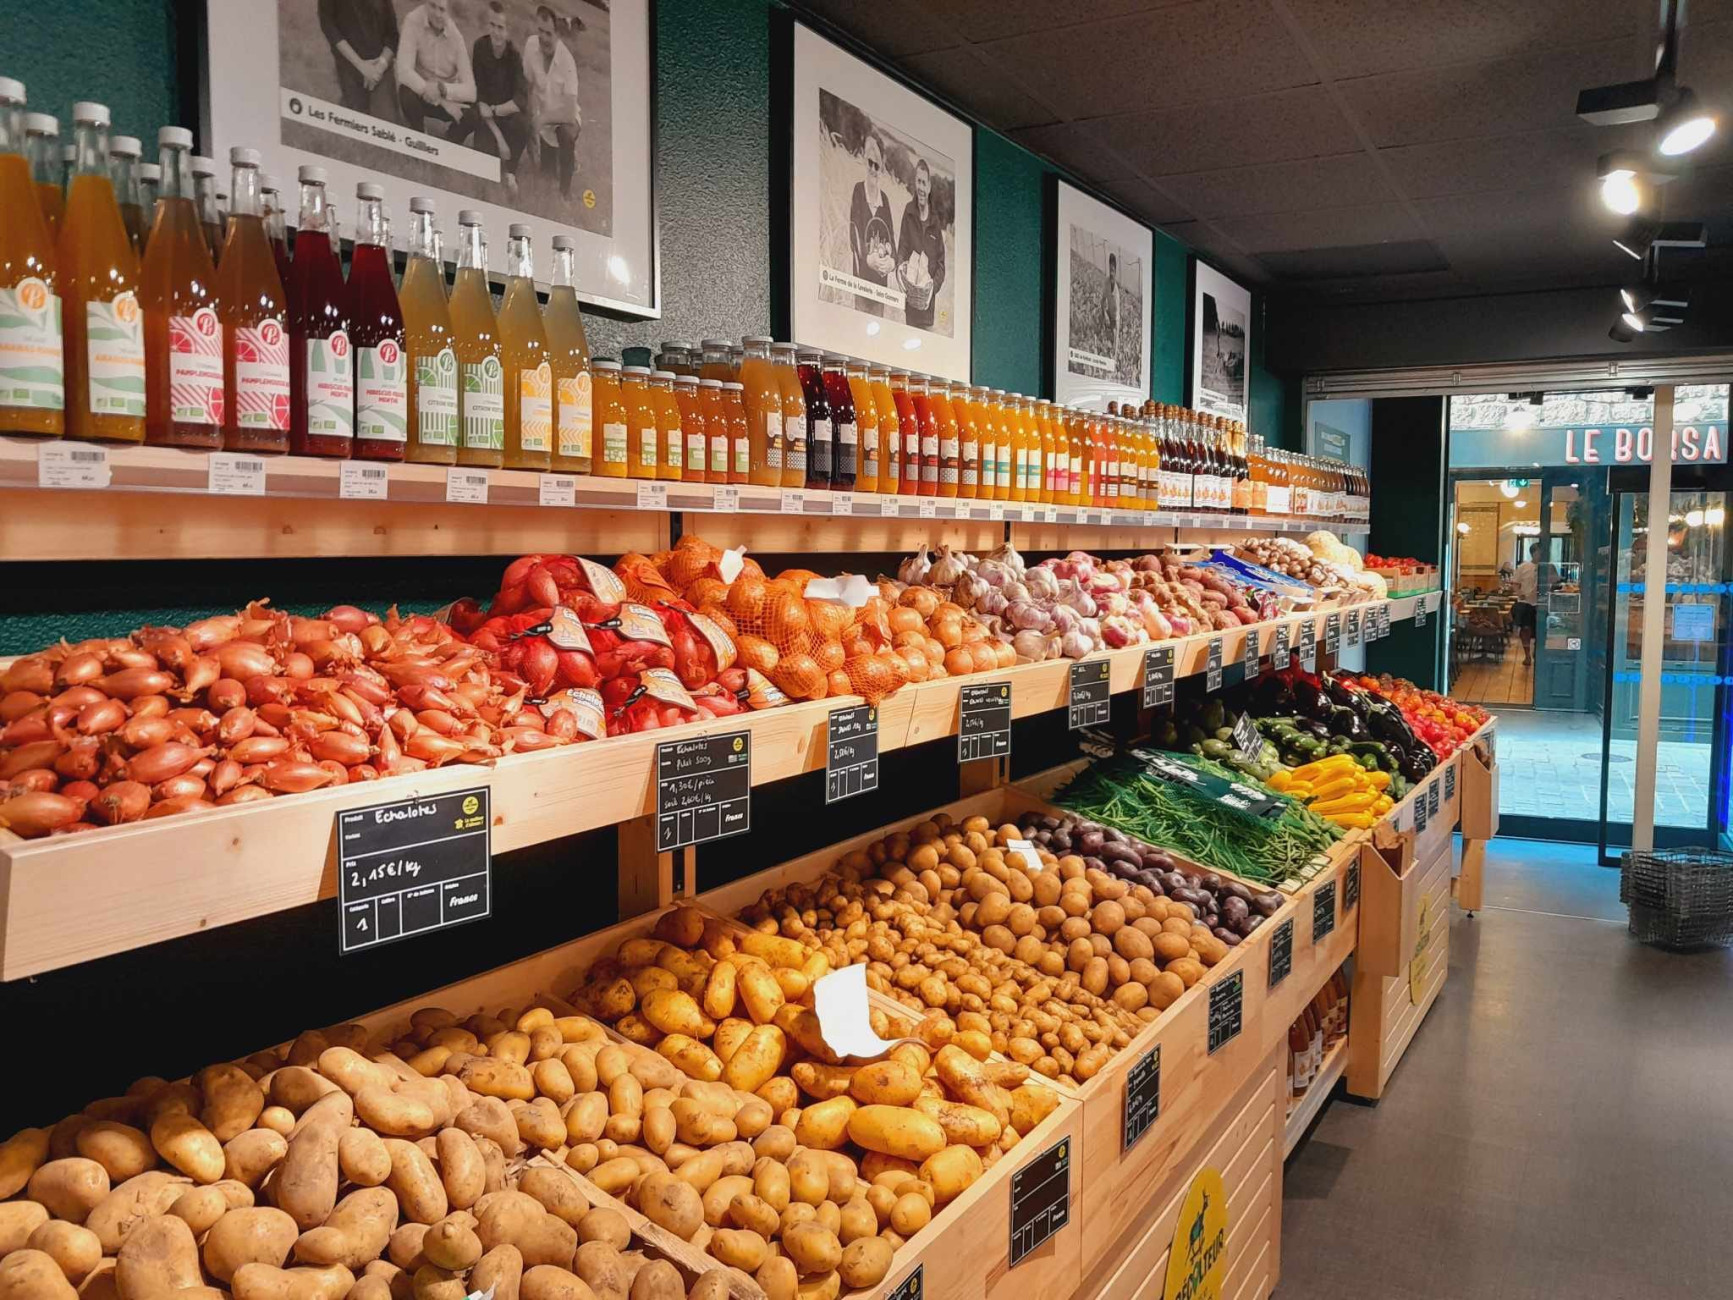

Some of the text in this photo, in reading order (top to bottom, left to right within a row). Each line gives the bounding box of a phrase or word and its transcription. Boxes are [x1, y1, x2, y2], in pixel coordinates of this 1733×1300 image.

[308, 105, 325, 121] Les
[328, 112, 369, 134] Fermiers
[1565, 428, 1601, 463] LE
[695, 755, 712, 766] 500g
[375, 803, 437, 824] Echalotes
[449, 893, 478, 907] France
[356, 917, 368, 931] 1
